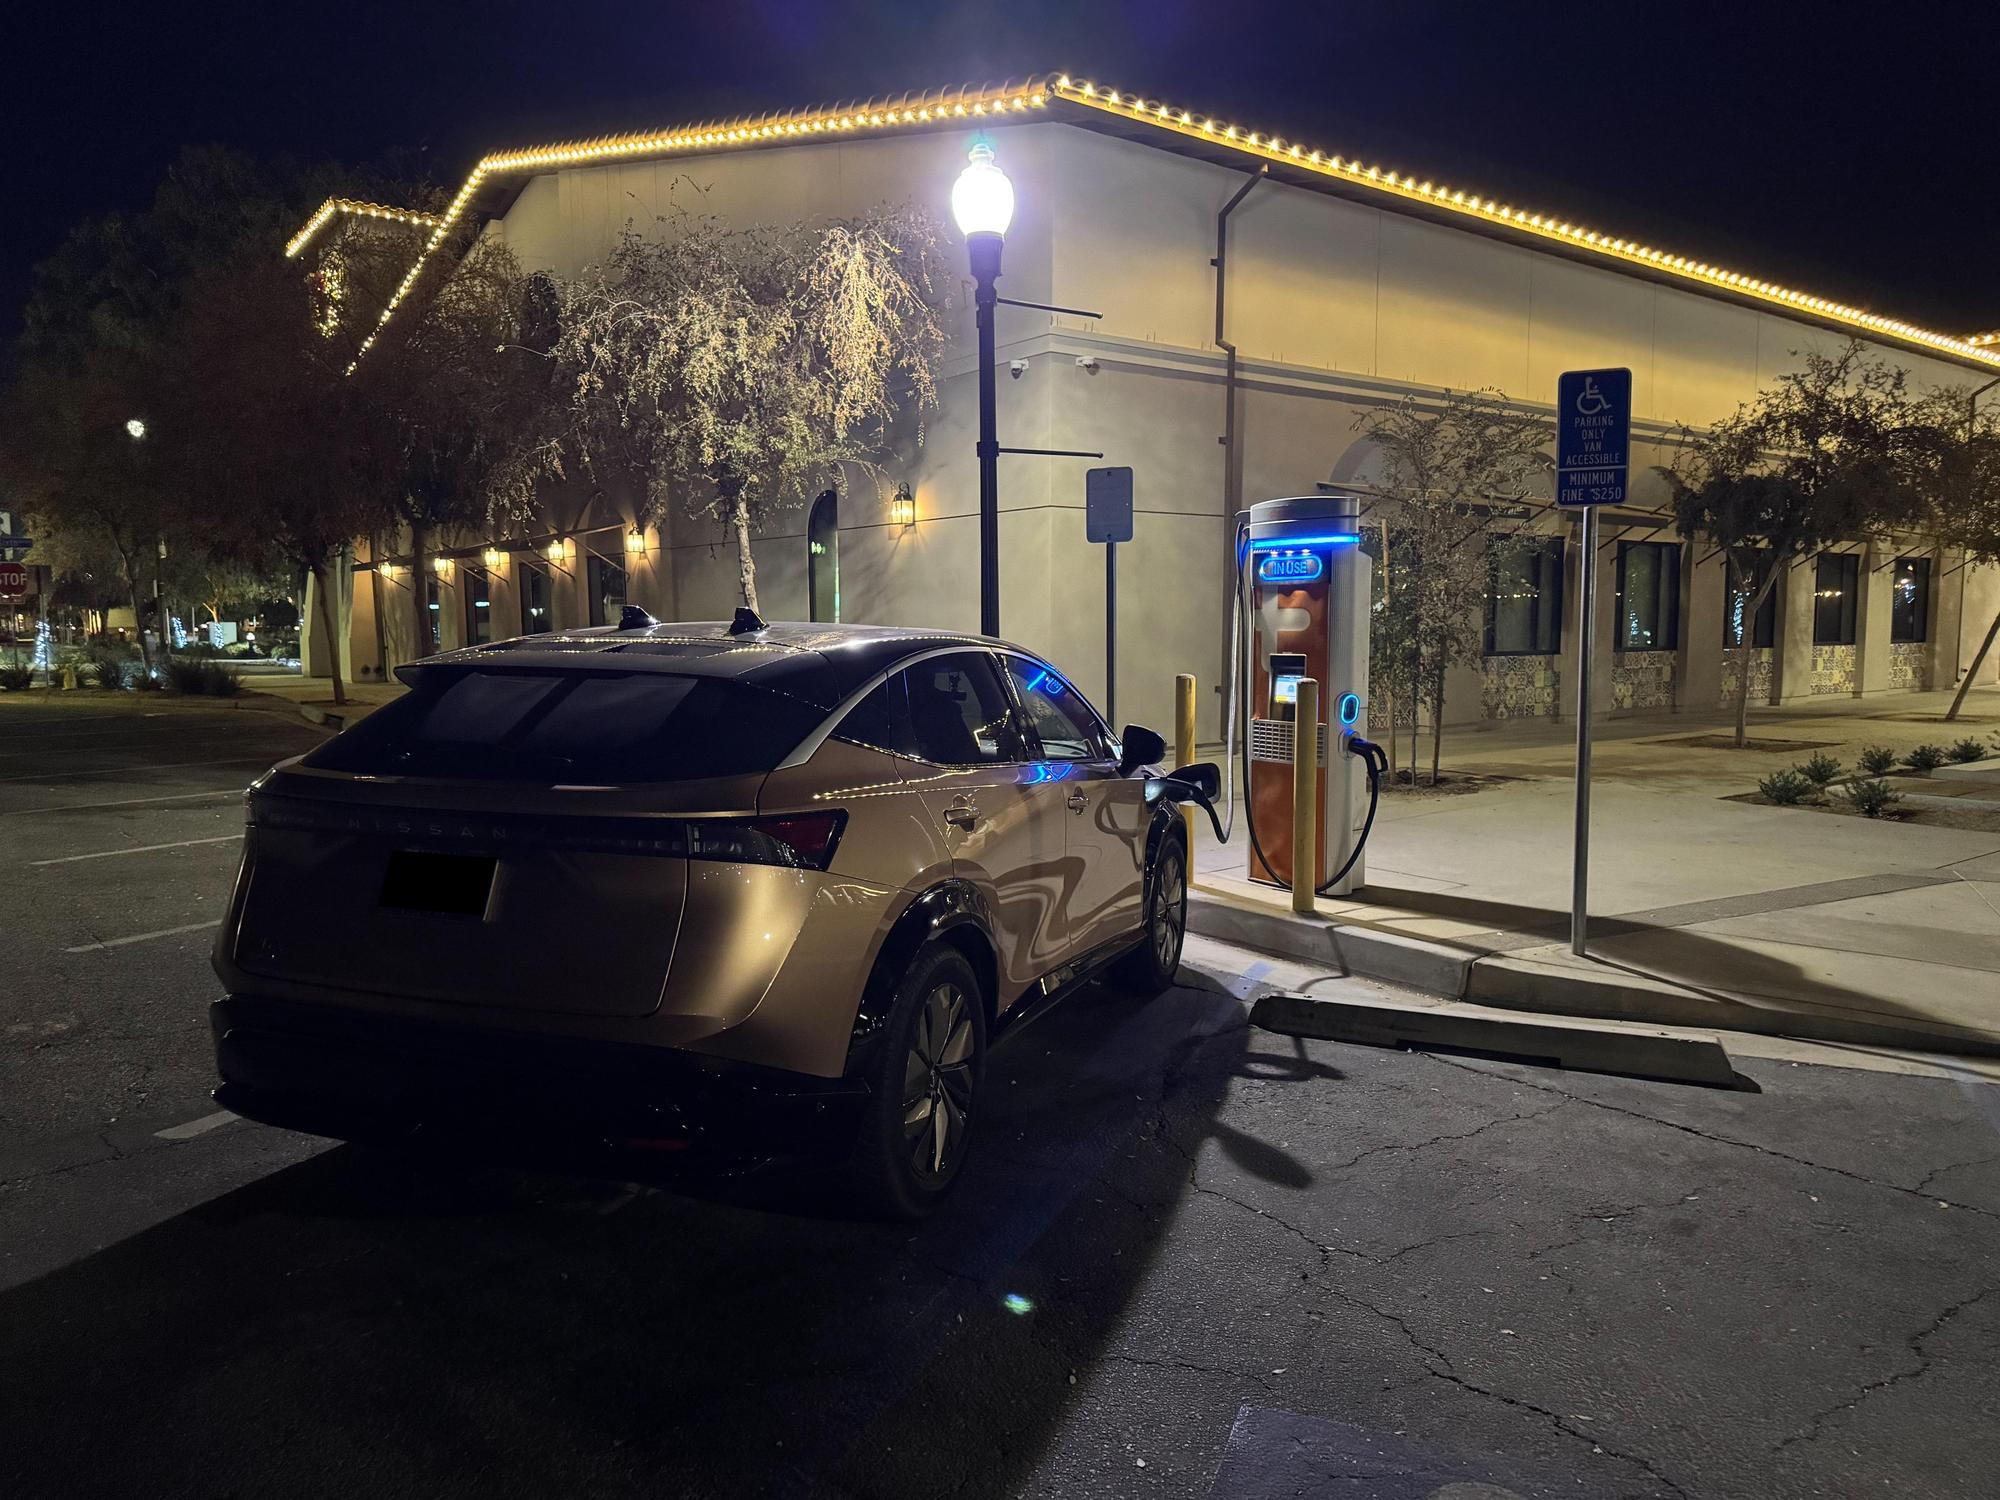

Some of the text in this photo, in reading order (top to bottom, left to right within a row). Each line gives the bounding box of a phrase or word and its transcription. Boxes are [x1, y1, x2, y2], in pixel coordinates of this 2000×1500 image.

[1574, 415, 1614, 428] PARKING
[1582, 428, 1606, 440] ONLY
[1584, 441, 1602, 453] VAN
[1566, 453, 1620, 465] ACCESSIBLE
[1569, 472, 1615, 485] MINIMUM
[1561, 486, 1622, 502] FINE $250
[1273, 561, 1307, 575] IN USE
[346, 818, 508, 840] NISSAN
